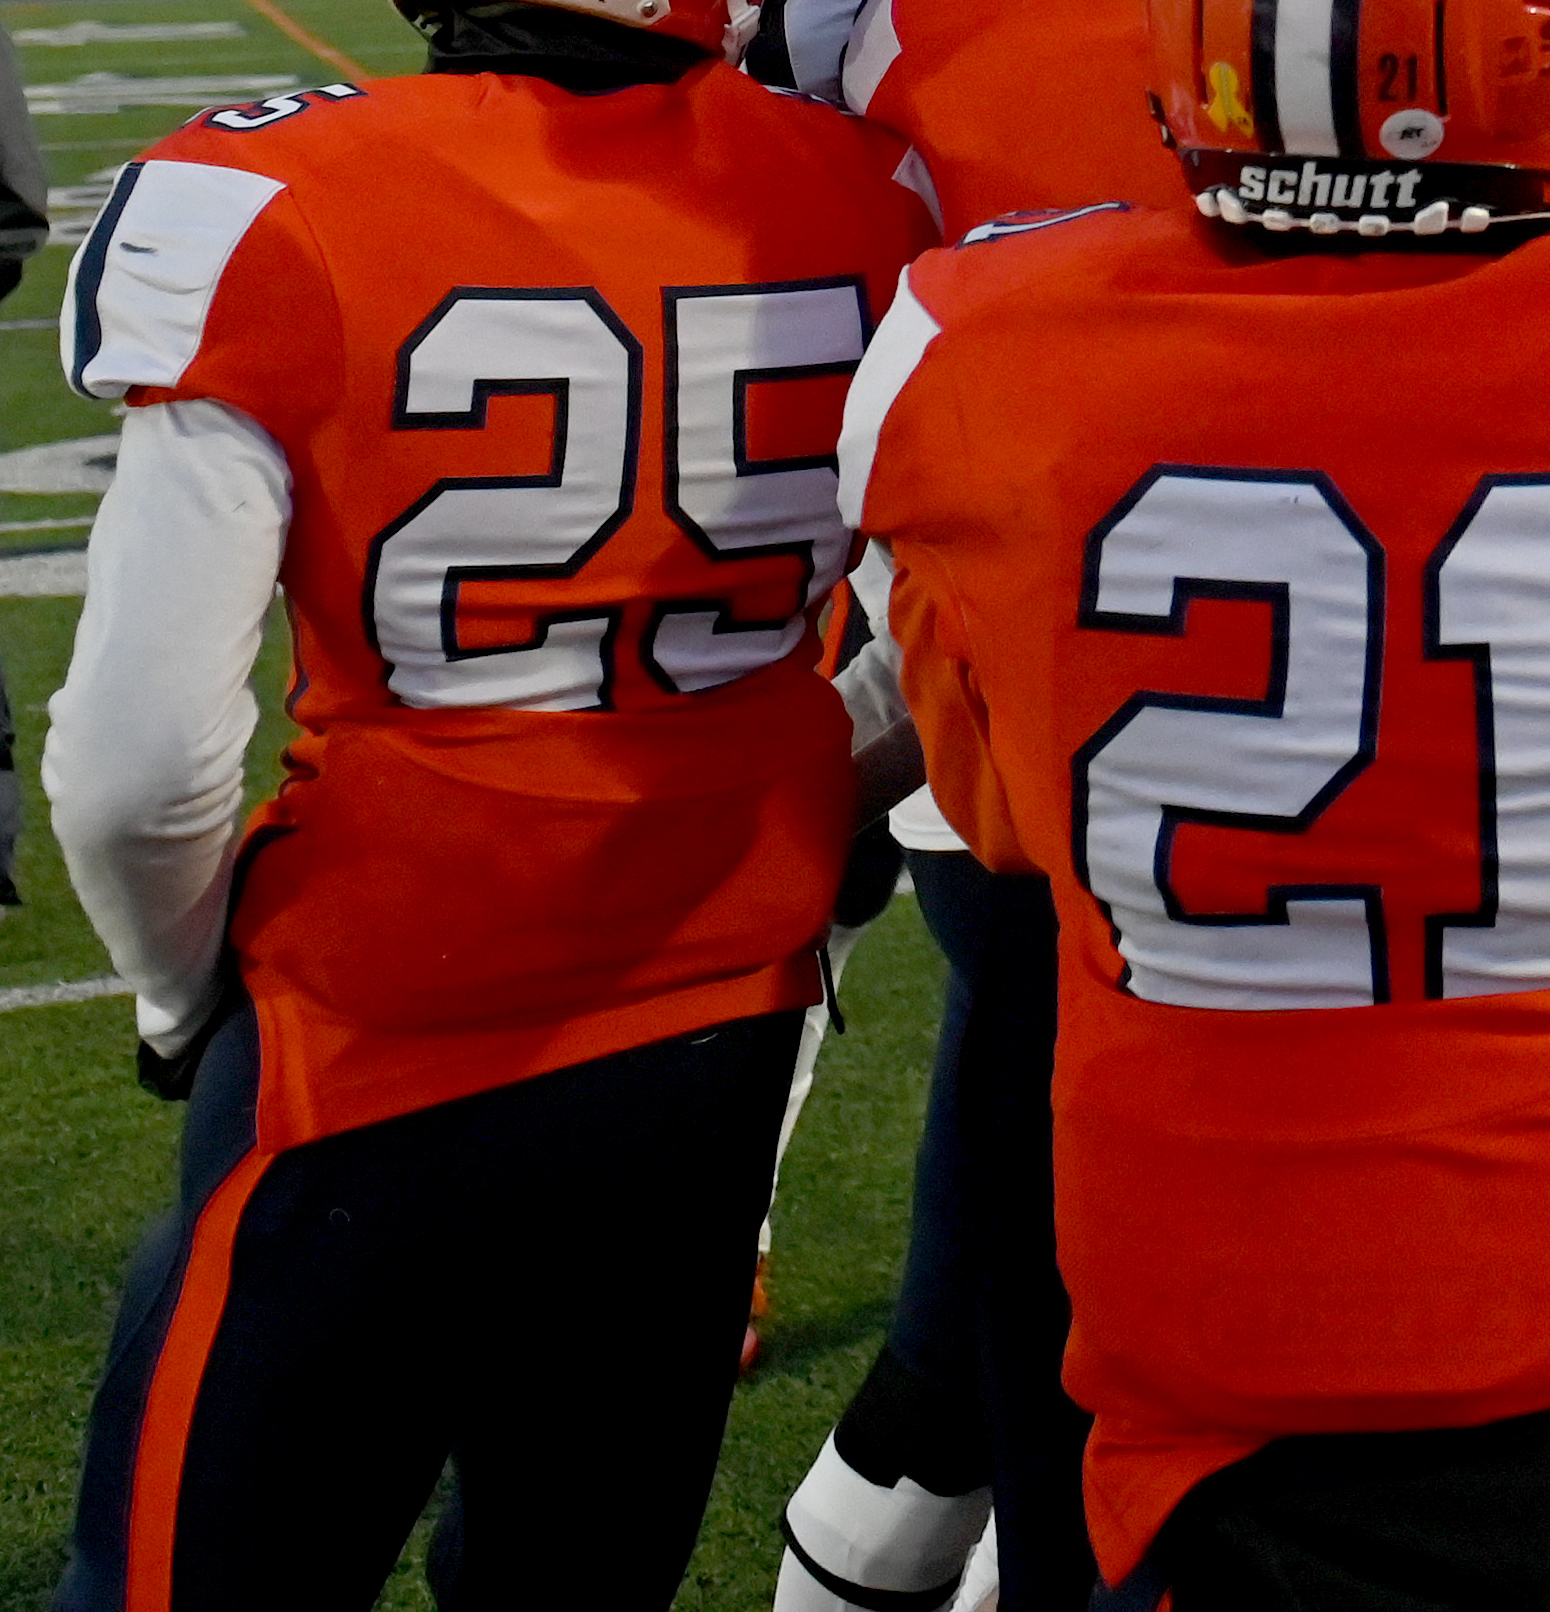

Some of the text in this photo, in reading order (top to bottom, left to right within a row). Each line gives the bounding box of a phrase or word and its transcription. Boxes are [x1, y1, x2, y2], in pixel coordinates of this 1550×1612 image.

[1377, 53, 1418, 102] 21
[1239, 162, 1423, 209] schutt
[363, 273, 872, 713] 25
